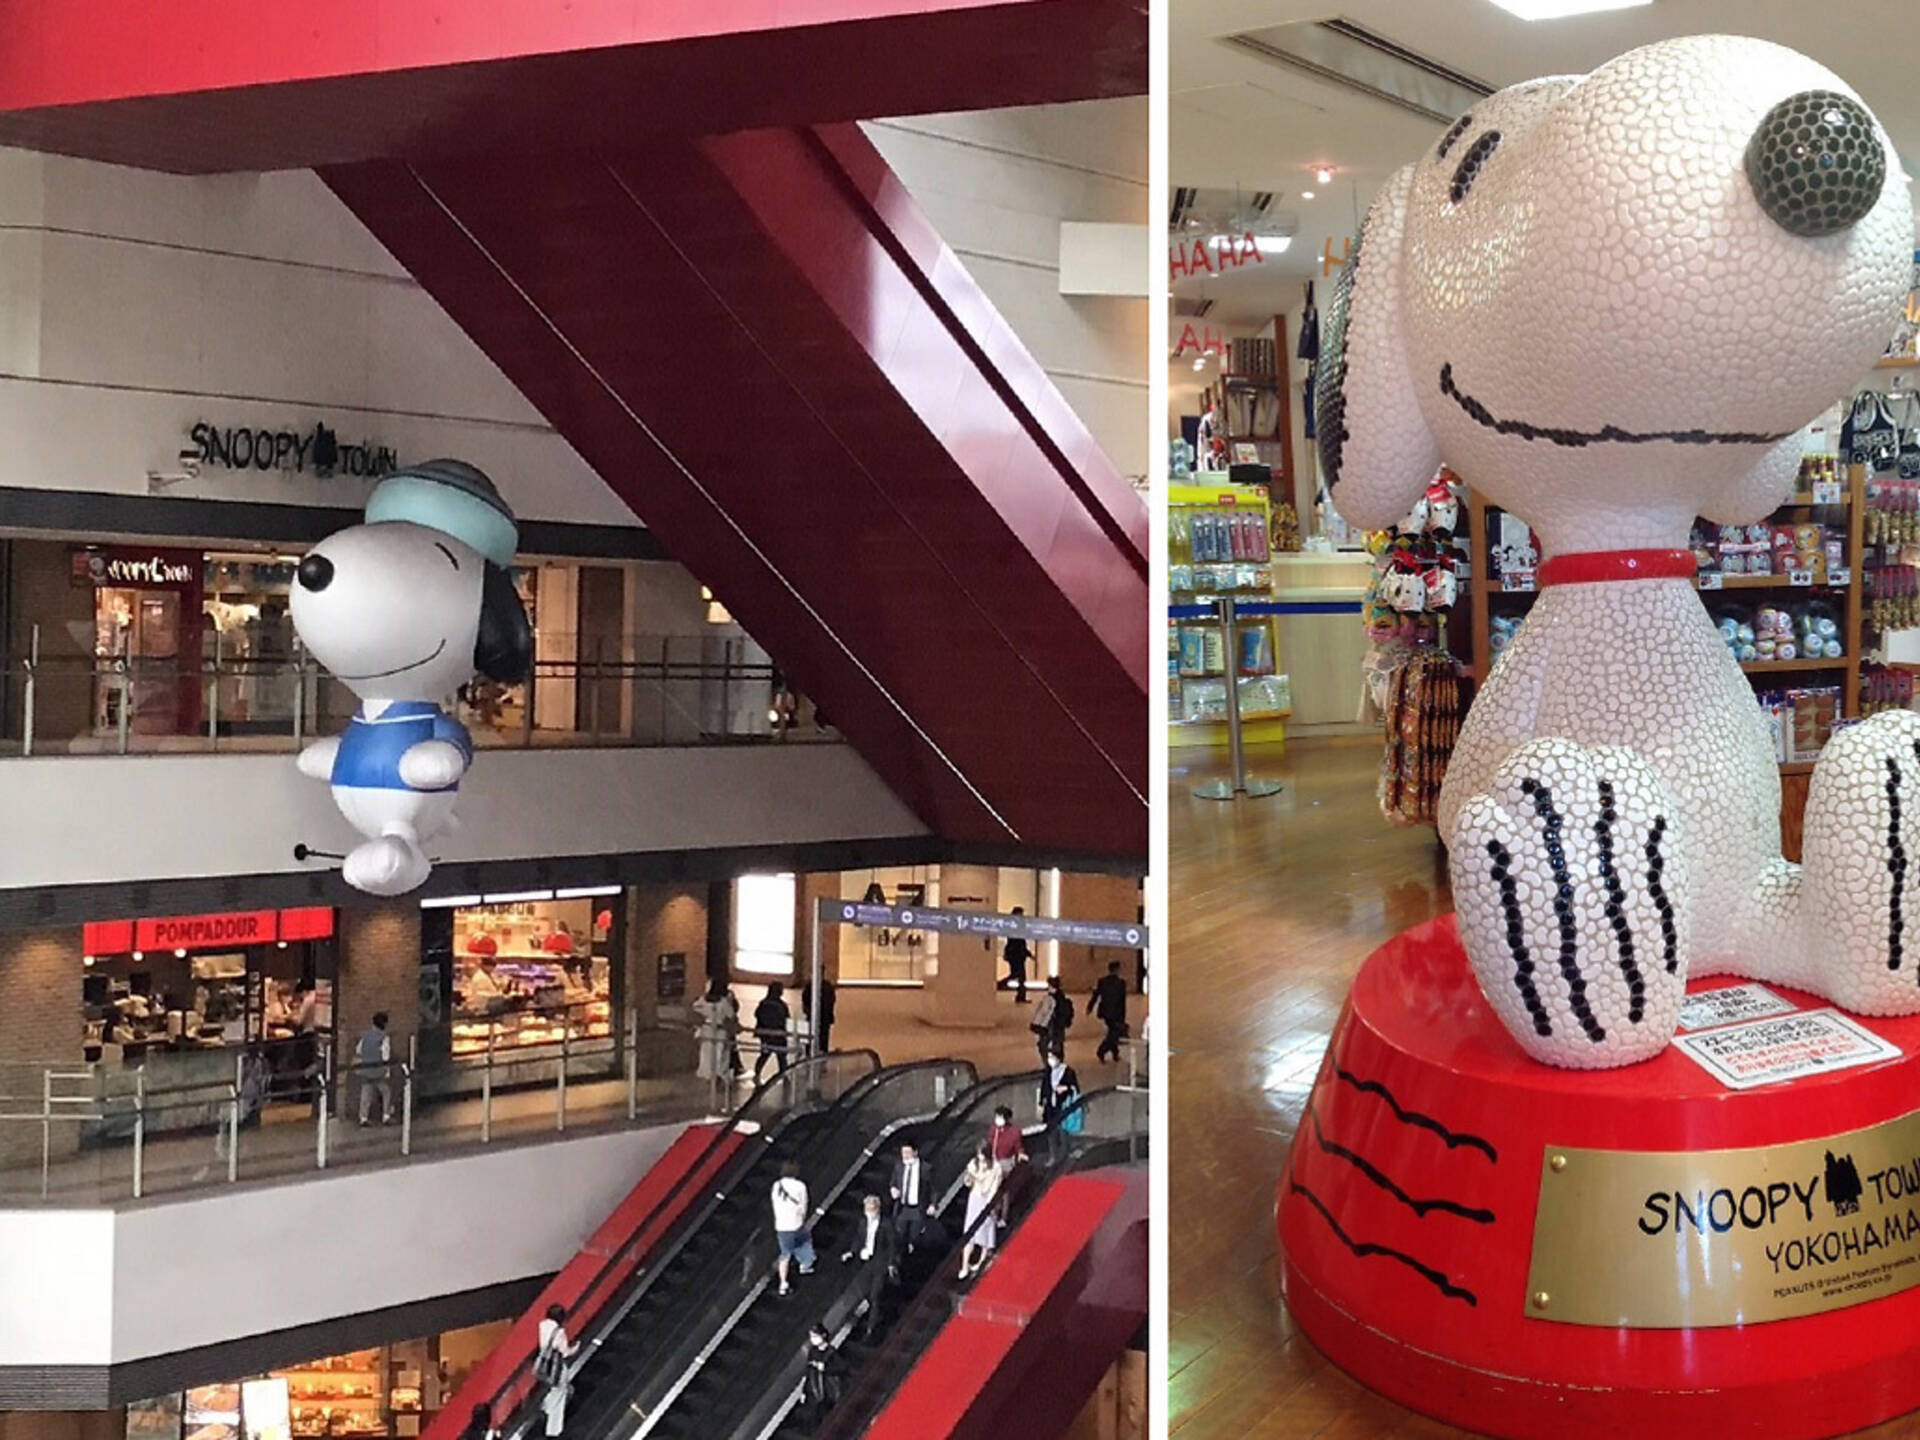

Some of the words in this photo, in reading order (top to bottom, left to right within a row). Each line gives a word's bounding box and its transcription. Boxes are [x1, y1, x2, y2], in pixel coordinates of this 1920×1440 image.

[191, 422, 314, 473] SNOOPY
[338, 443, 398, 477] TOWN
[154, 916, 259, 944] POMPADOUR
[1638, 1175, 1820, 1236] SNOOPY
[1765, 1208, 1920, 1274] YOKOHAMA
